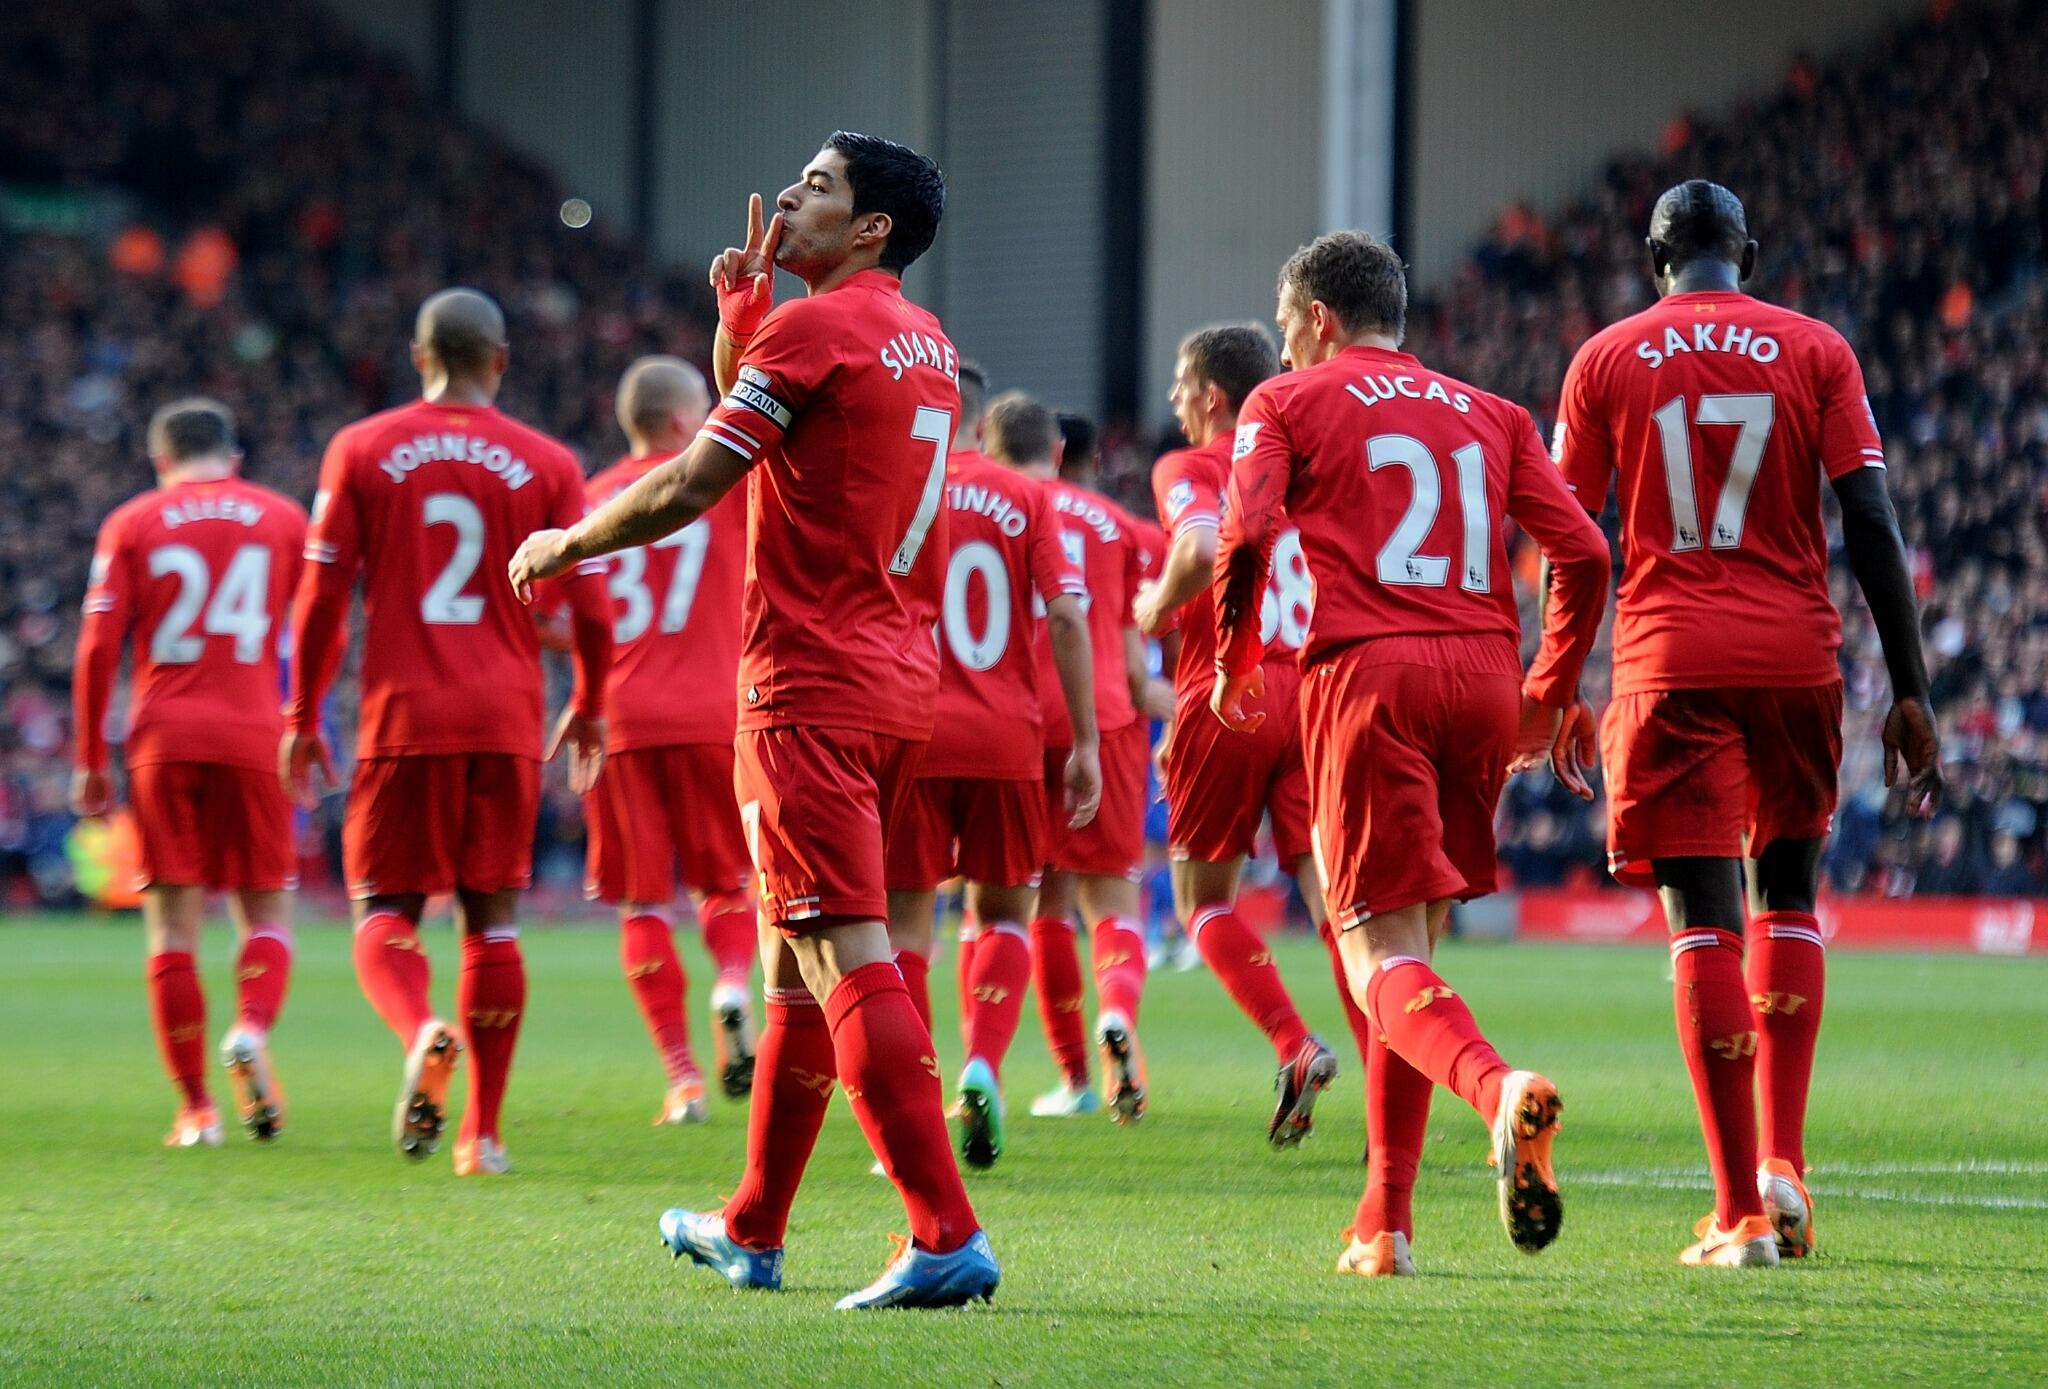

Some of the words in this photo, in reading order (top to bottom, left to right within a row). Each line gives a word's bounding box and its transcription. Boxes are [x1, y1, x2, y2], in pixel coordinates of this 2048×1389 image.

[1345, 374, 1472, 414] LUCAS
[1636, 322, 1780, 369] SAKHO
[160, 496, 266, 530] ALLEN
[379, 433, 535, 491] JOHNSON
[888, 405, 951, 576] 7
[1366, 434, 1491, 593] 21
[1652, 393, 1775, 553] 17
[147, 543, 273, 666] 24
[420, 492, 486, 625] 2
[607, 518, 711, 645] 37
[932, 541, 1012, 672] 0
